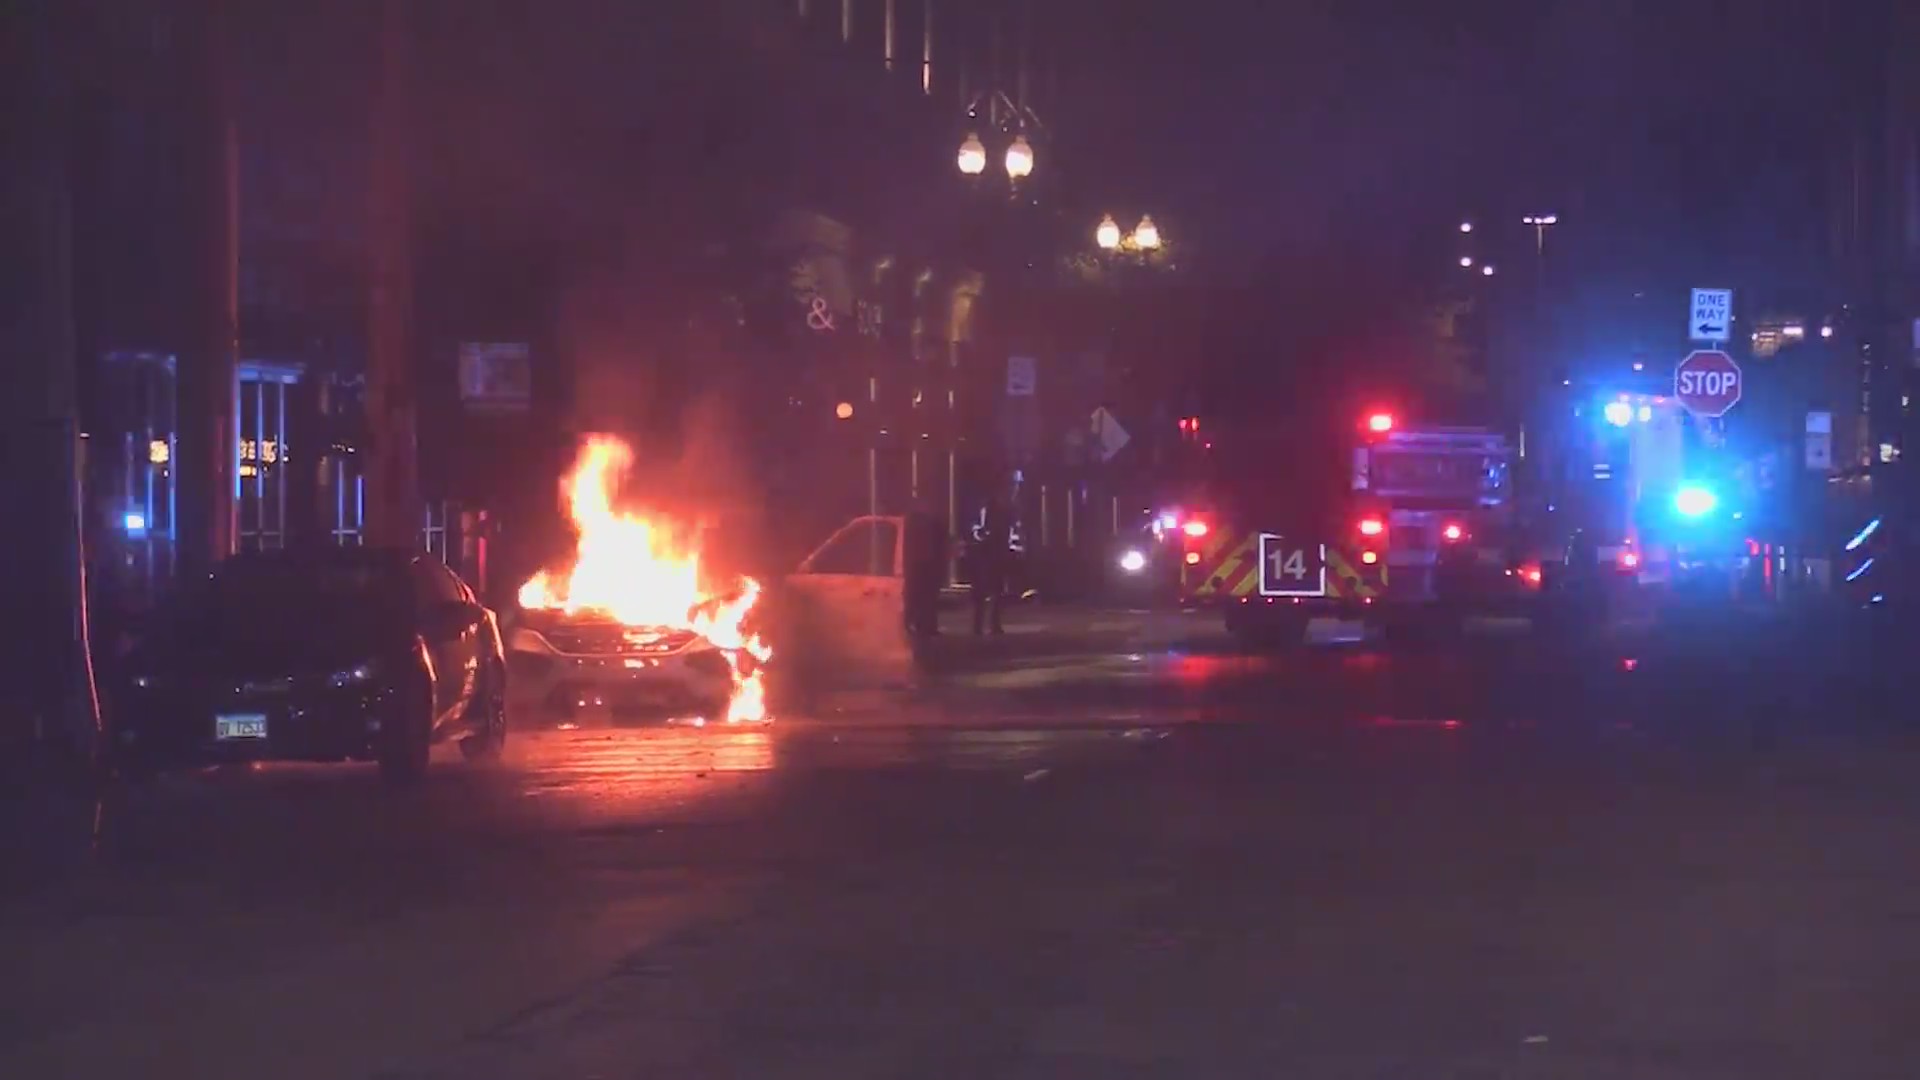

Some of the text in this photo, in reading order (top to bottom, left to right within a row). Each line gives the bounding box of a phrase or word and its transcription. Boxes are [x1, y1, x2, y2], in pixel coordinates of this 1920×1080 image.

[1697, 293, 1726, 307] ONE
[806, 297, 835, 330] &
[1696, 308, 1726, 321] WAY
[1679, 370, 1737, 396] STOP
[1267, 549, 1307, 580] 14
